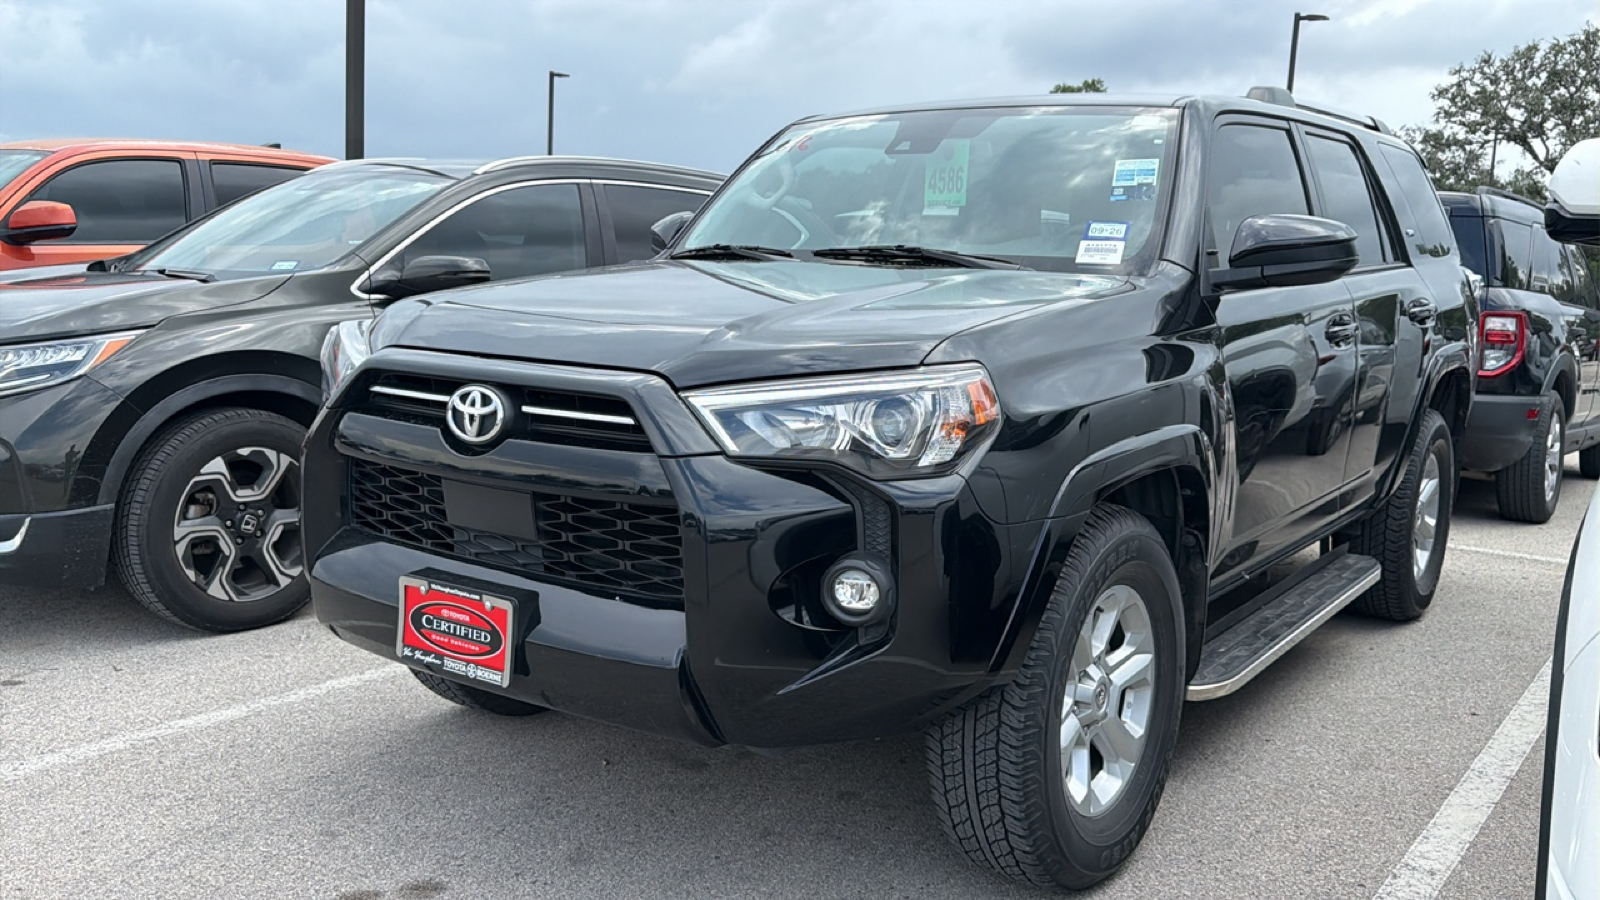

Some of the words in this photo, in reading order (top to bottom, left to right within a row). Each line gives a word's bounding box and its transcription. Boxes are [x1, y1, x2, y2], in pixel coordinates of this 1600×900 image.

[928, 165, 964, 195] 4586
[421, 614, 491, 643] CERTIFIED
[449, 610, 470, 622] TOYOTA
[443, 658, 467, 672] TOYOTA
[476, 668, 502, 682] BOERNE
